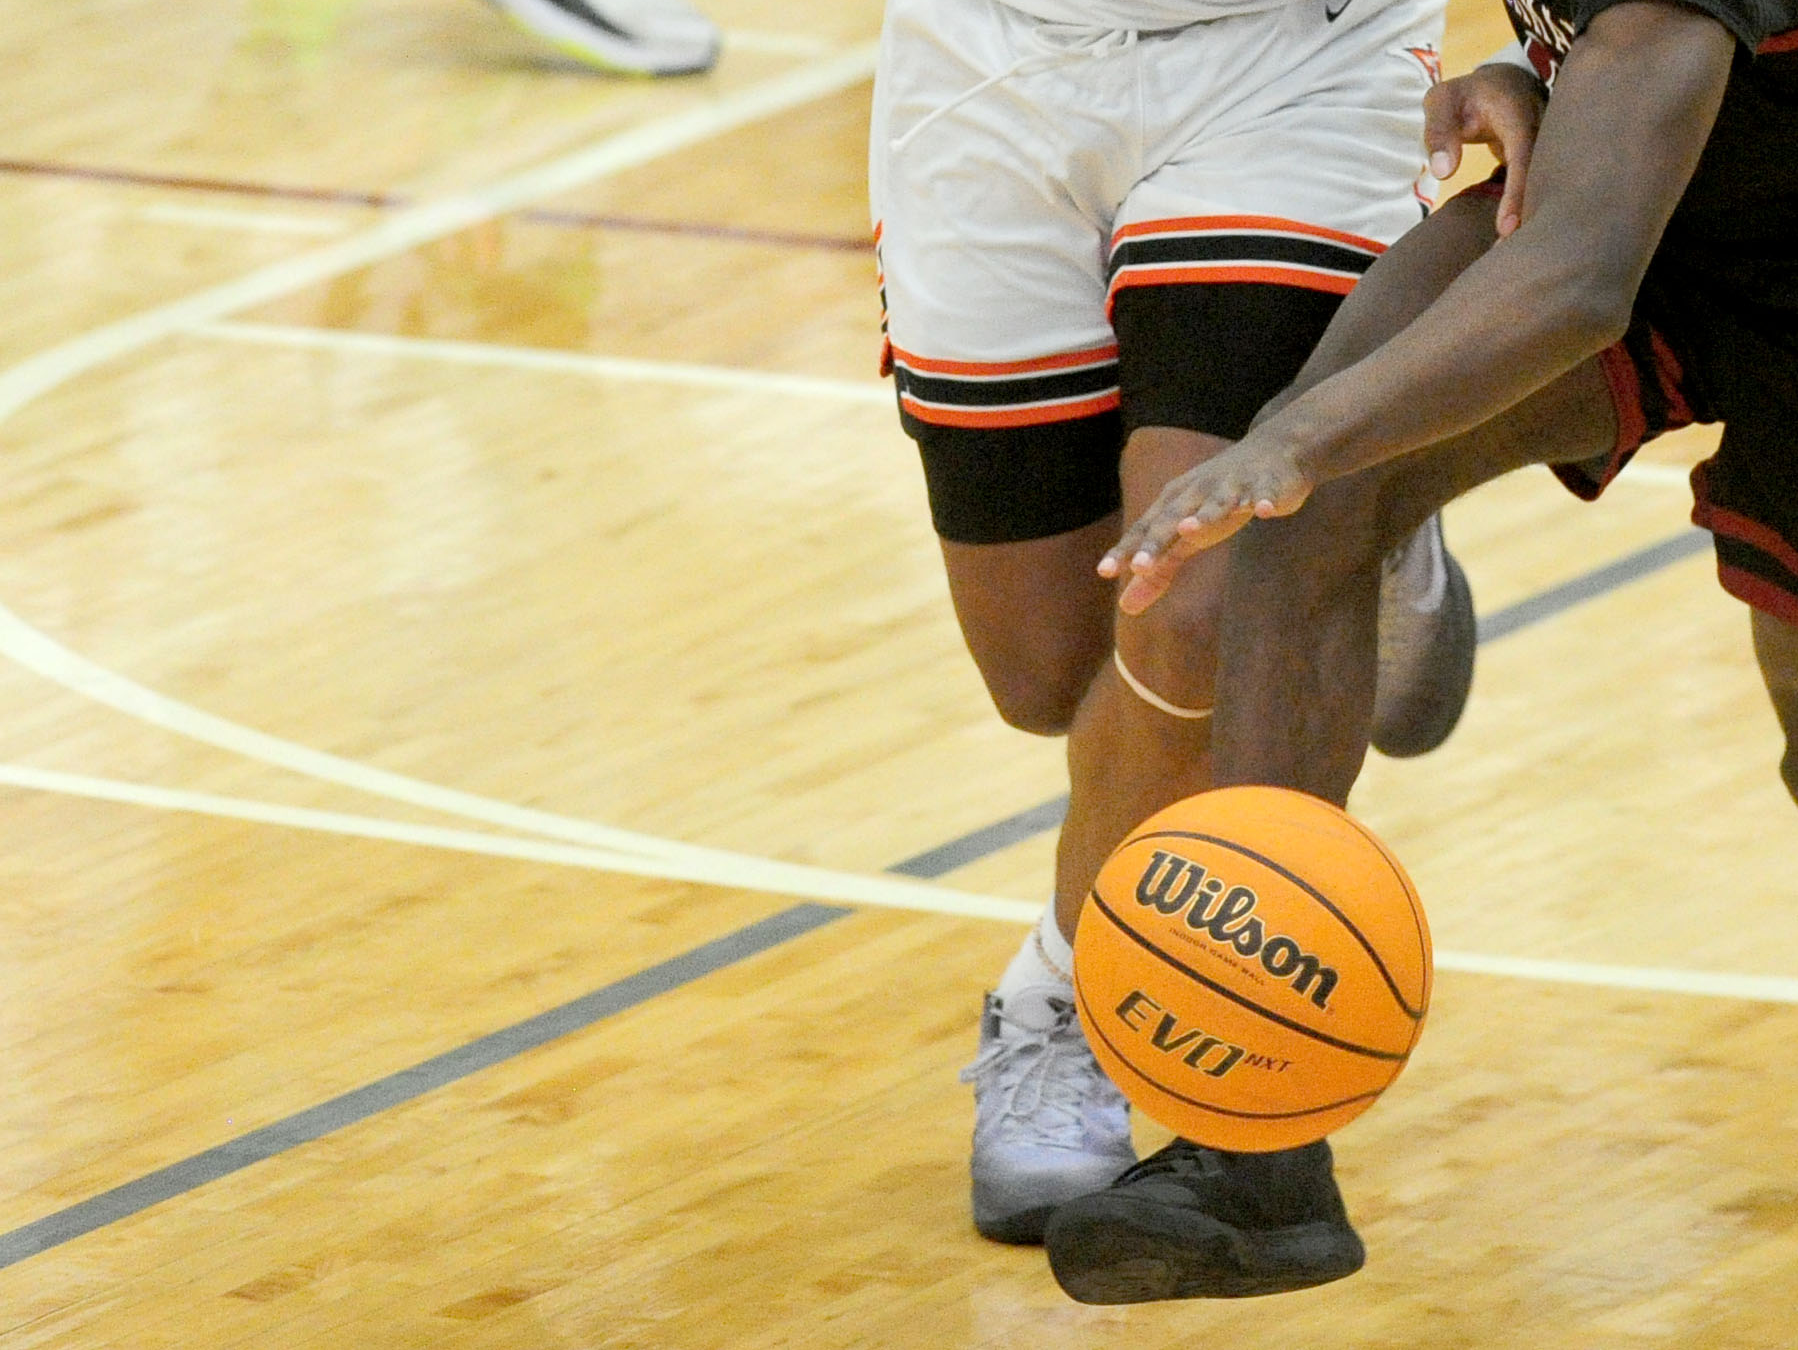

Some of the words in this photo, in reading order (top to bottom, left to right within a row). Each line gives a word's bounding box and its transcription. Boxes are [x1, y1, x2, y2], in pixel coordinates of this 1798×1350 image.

[1134, 849, 1340, 1012] Wilson
[1114, 989, 1247, 1078] EVO
[1244, 1052, 1294, 1073] NXT
